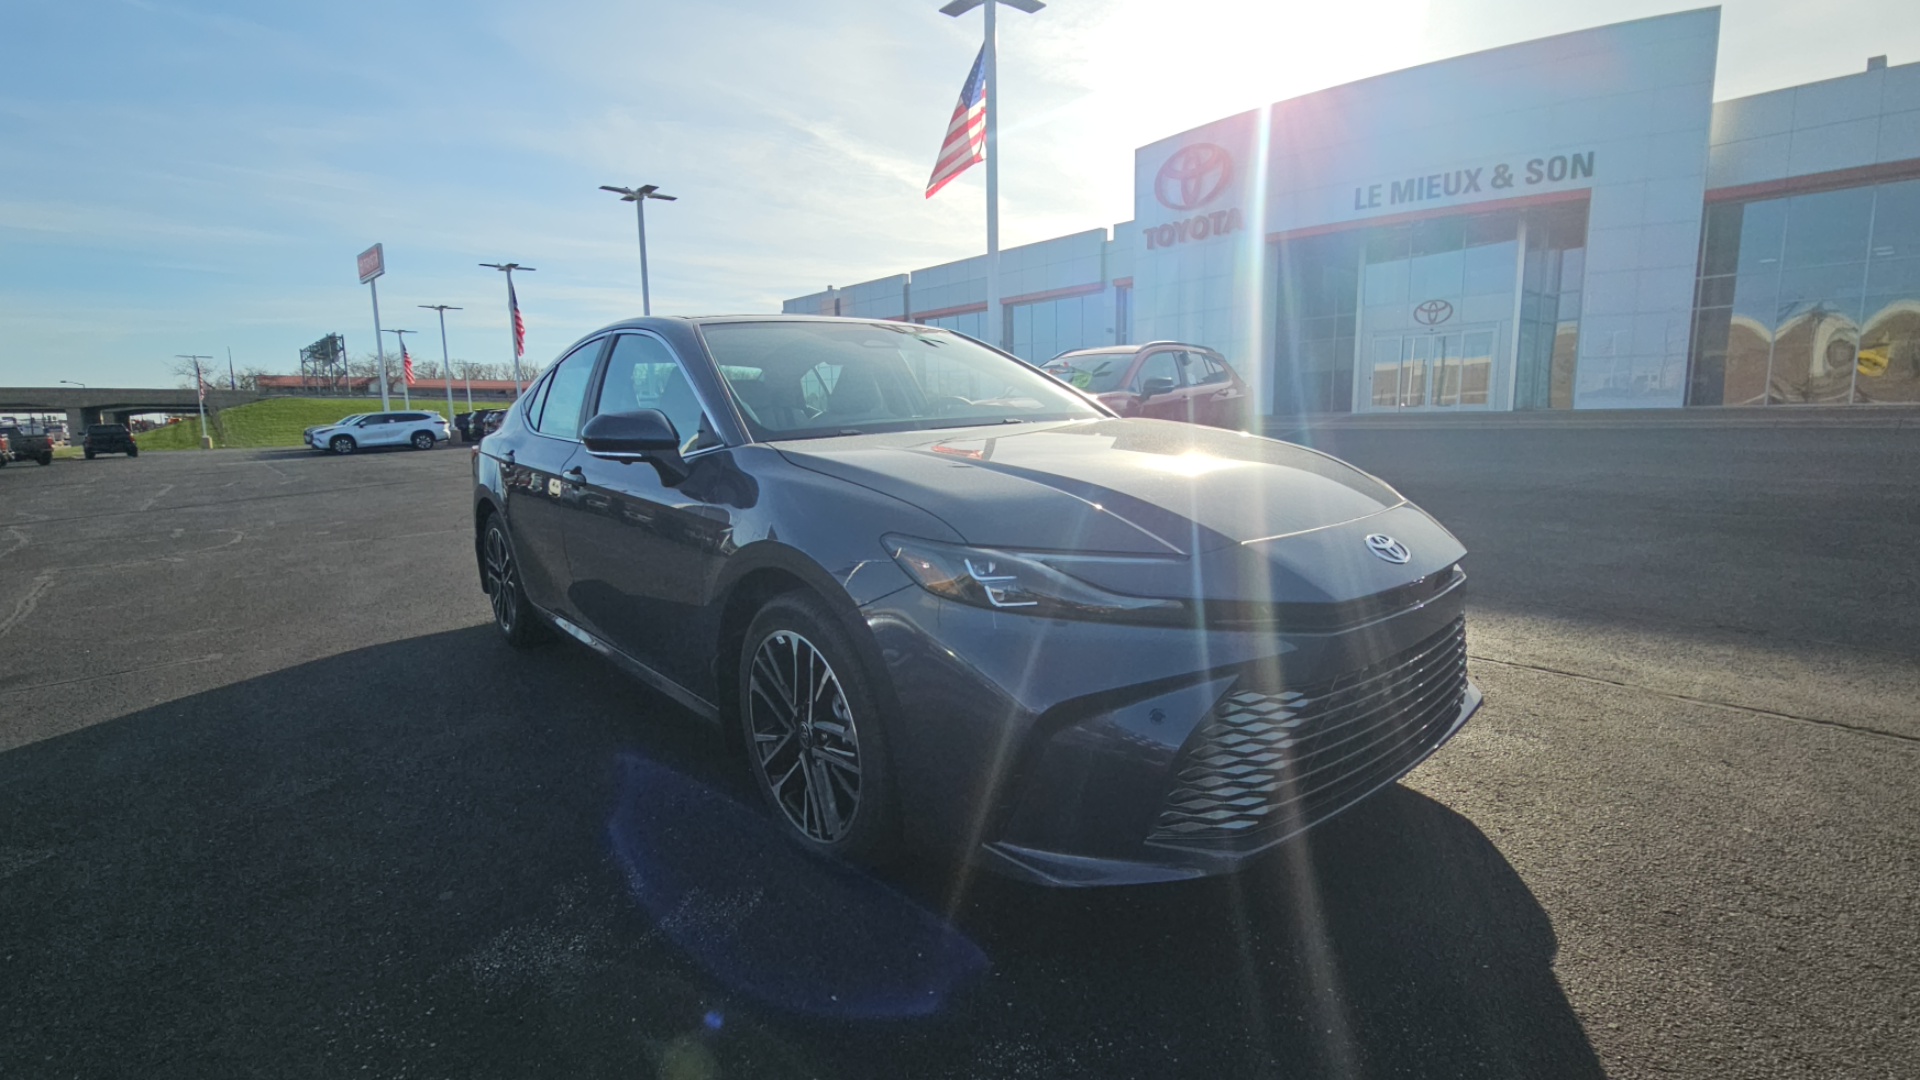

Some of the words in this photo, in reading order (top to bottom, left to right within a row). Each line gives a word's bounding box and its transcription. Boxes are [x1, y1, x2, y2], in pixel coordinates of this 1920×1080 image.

[1354, 183, 1382, 210] LE
[1390, 166, 1483, 206] MIEUX
[1490, 163, 1514, 189] &
[1525, 151, 1595, 185] SON
[1142, 207, 1244, 250] TOYOTA
